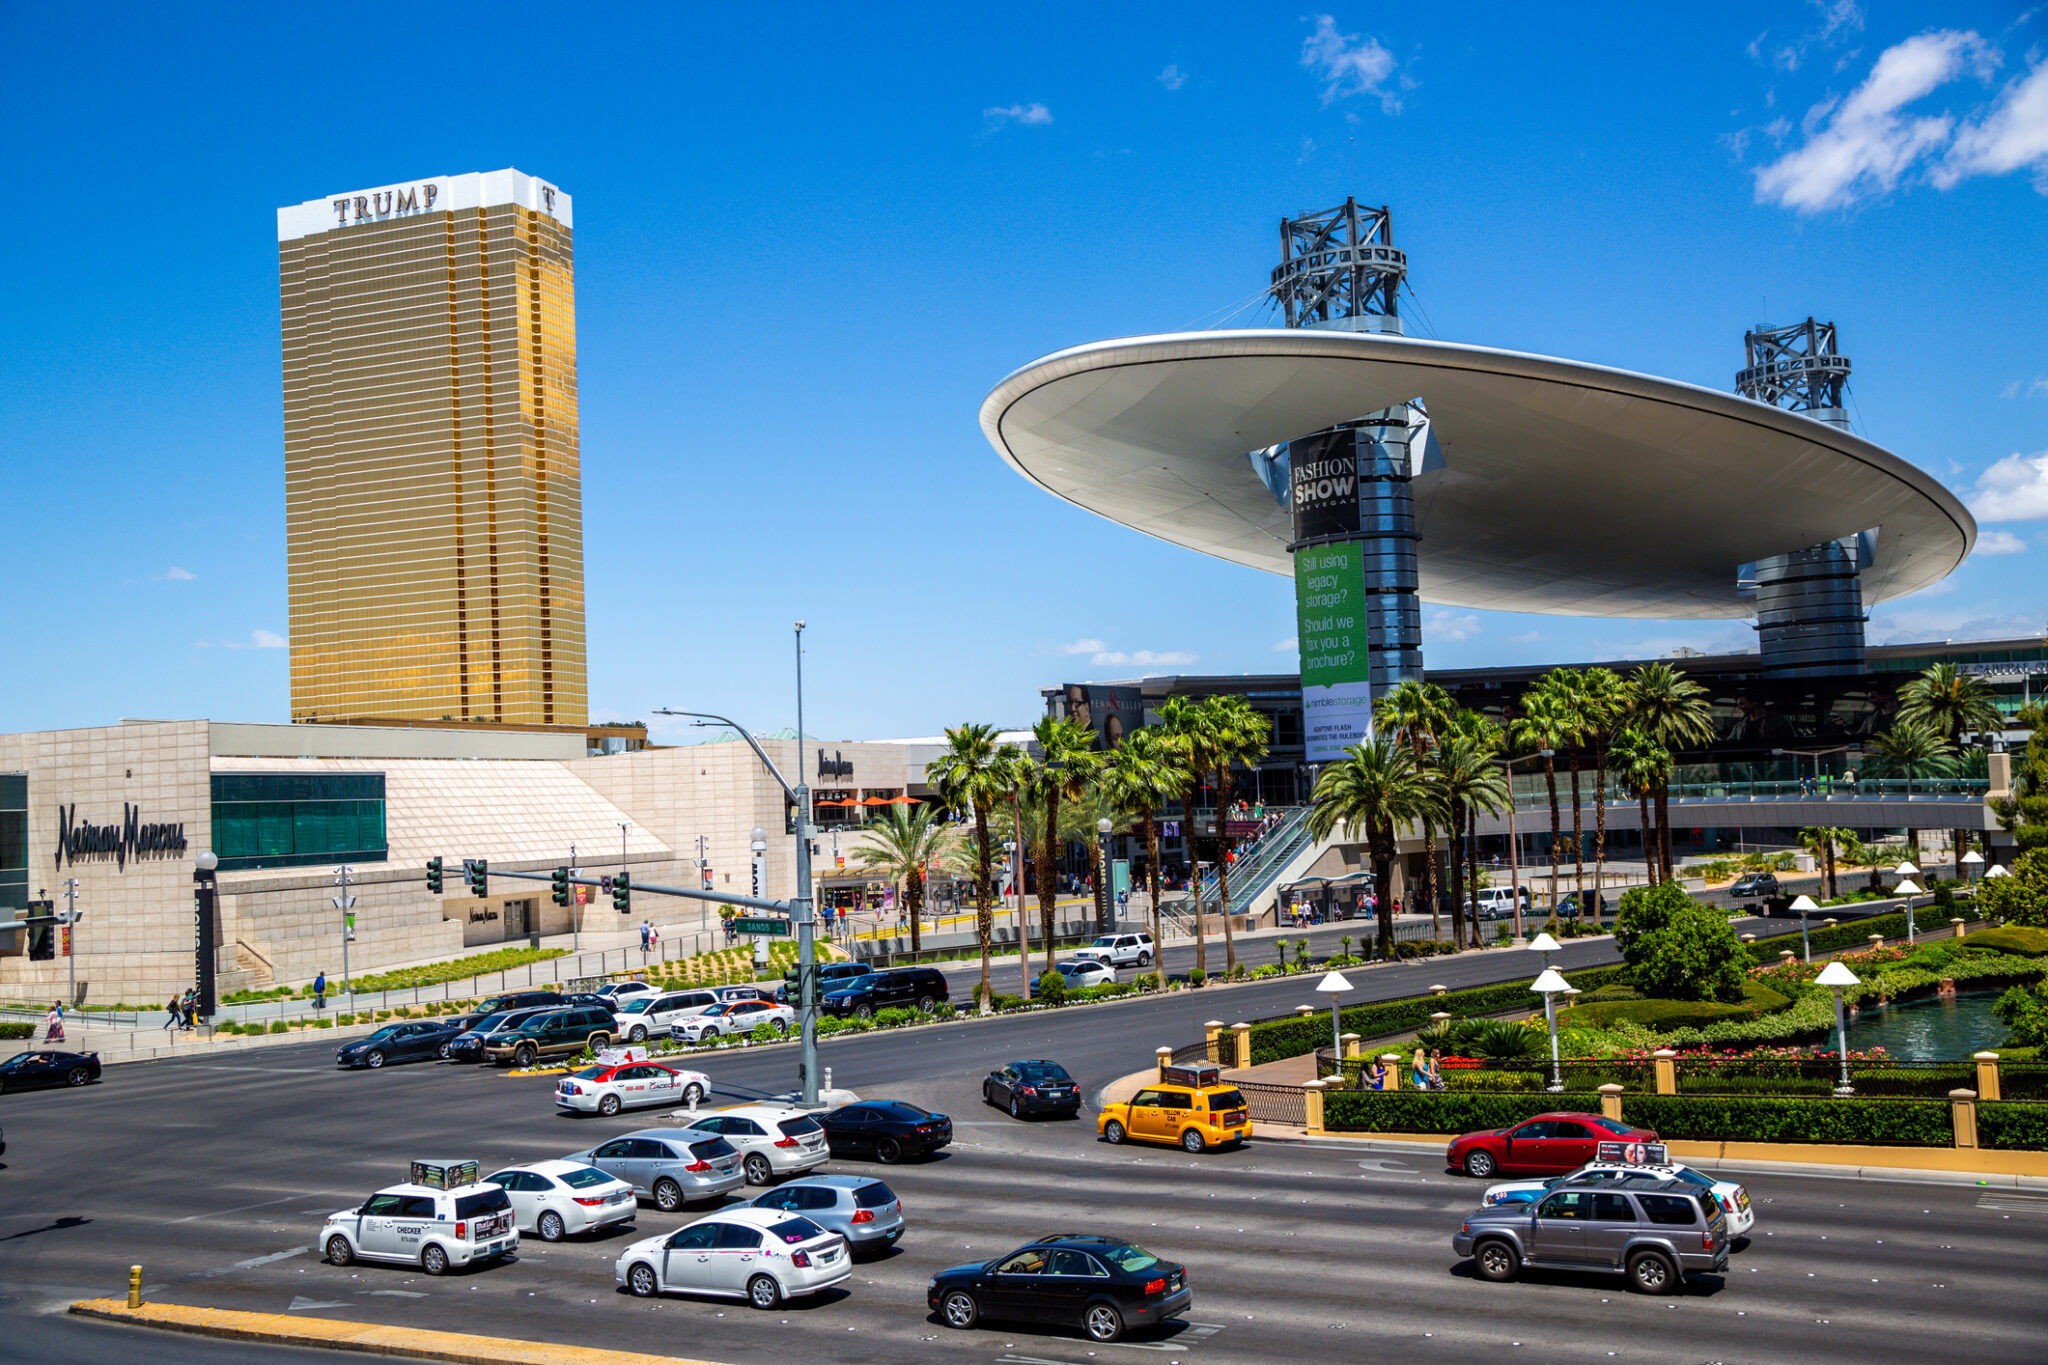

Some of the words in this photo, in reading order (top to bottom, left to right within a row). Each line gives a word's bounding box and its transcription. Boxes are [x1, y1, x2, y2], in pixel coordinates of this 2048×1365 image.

[333, 184, 438, 222] TRUMP
[543, 185, 555, 211] T
[1295, 457, 1355, 483] FASHION
[1295, 476, 1355, 505] SHOW
[1315, 498, 1357, 509] VEGAS
[1303, 557, 1316, 572] Still
[1320, 553, 1348, 570] using
[1307, 574, 1339, 592] legacy
[1305, 589, 1348, 608] storage?
[1304, 616, 1334, 634] Should
[1336, 617, 1354, 629] we
[1320, 638, 1339, 652] you
[1342, 636, 1350, 647] a
[1306, 651, 1355, 669] brochure?
[1334, 723, 1352, 731] FLASH
[55, 803, 120, 863] Neiman
[118, 802, 187, 862] Marcus
[747, 923, 770, 932] SANDS
[397, 1226, 422, 1235] CHECKER
